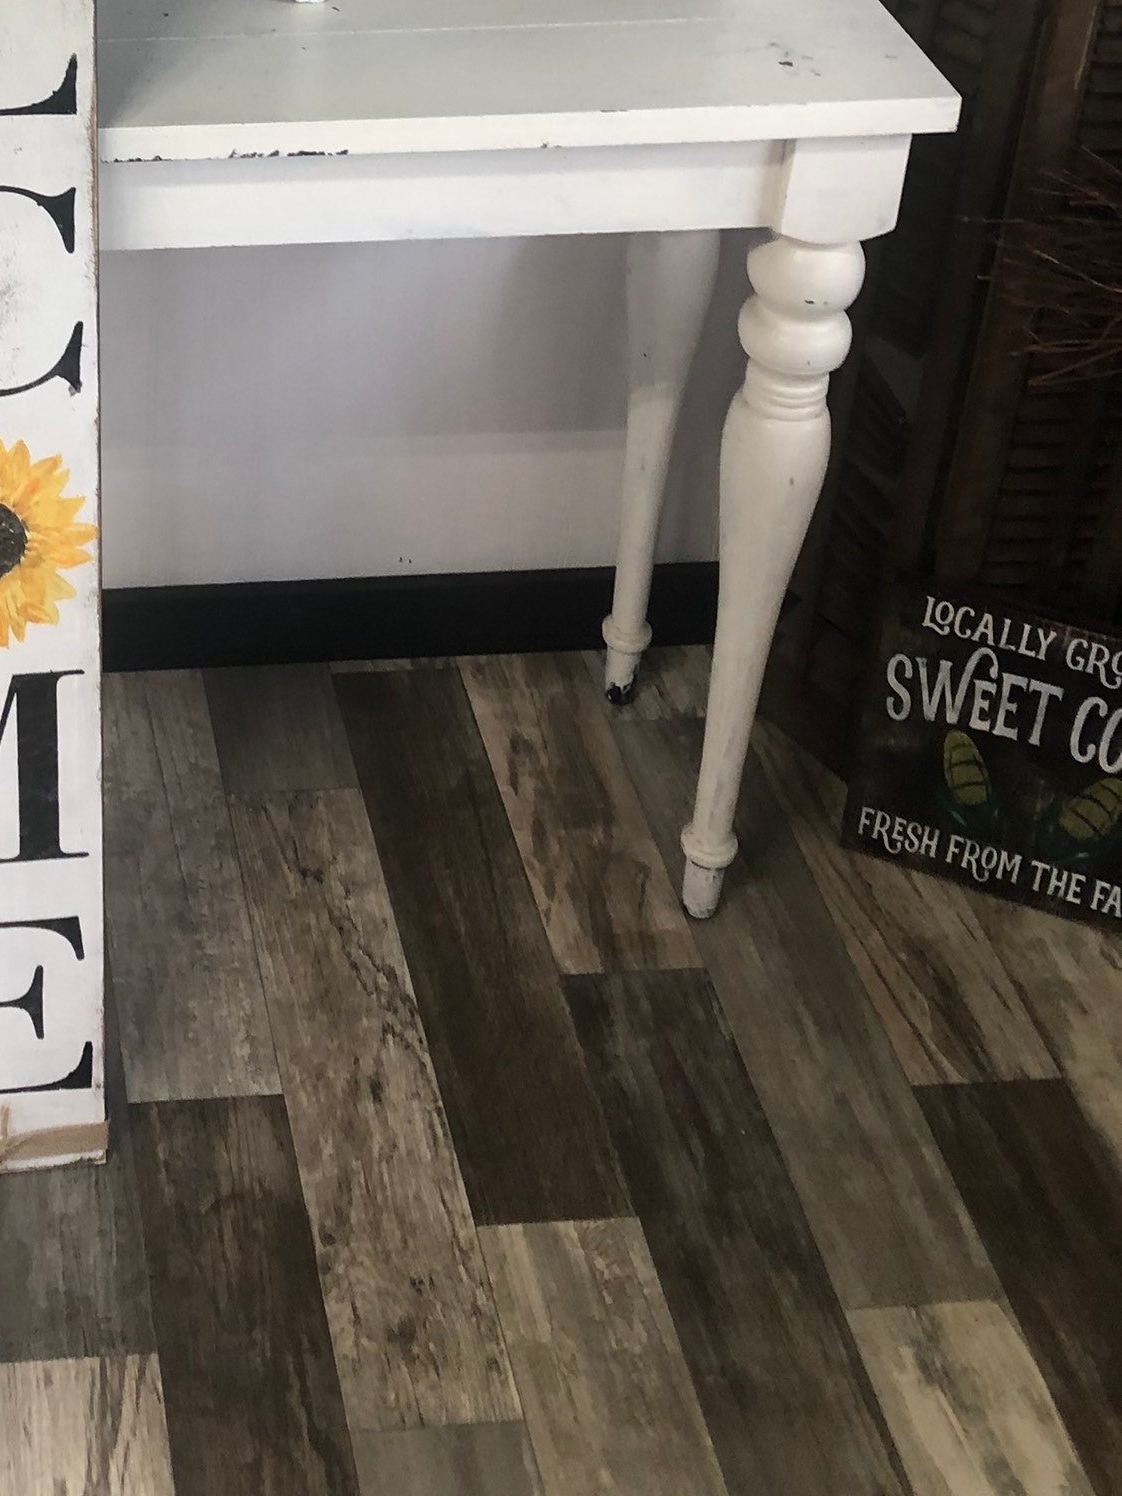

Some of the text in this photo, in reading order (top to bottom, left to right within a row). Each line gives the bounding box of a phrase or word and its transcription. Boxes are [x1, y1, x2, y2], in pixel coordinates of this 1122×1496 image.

[922, 595, 1057, 661] LOCALLY
[886, 647, 1064, 746] SWEET
[857, 807, 940, 858] FRESH
[945, 835, 1022, 883] FROM
[1030, 859, 1086, 904] THE
